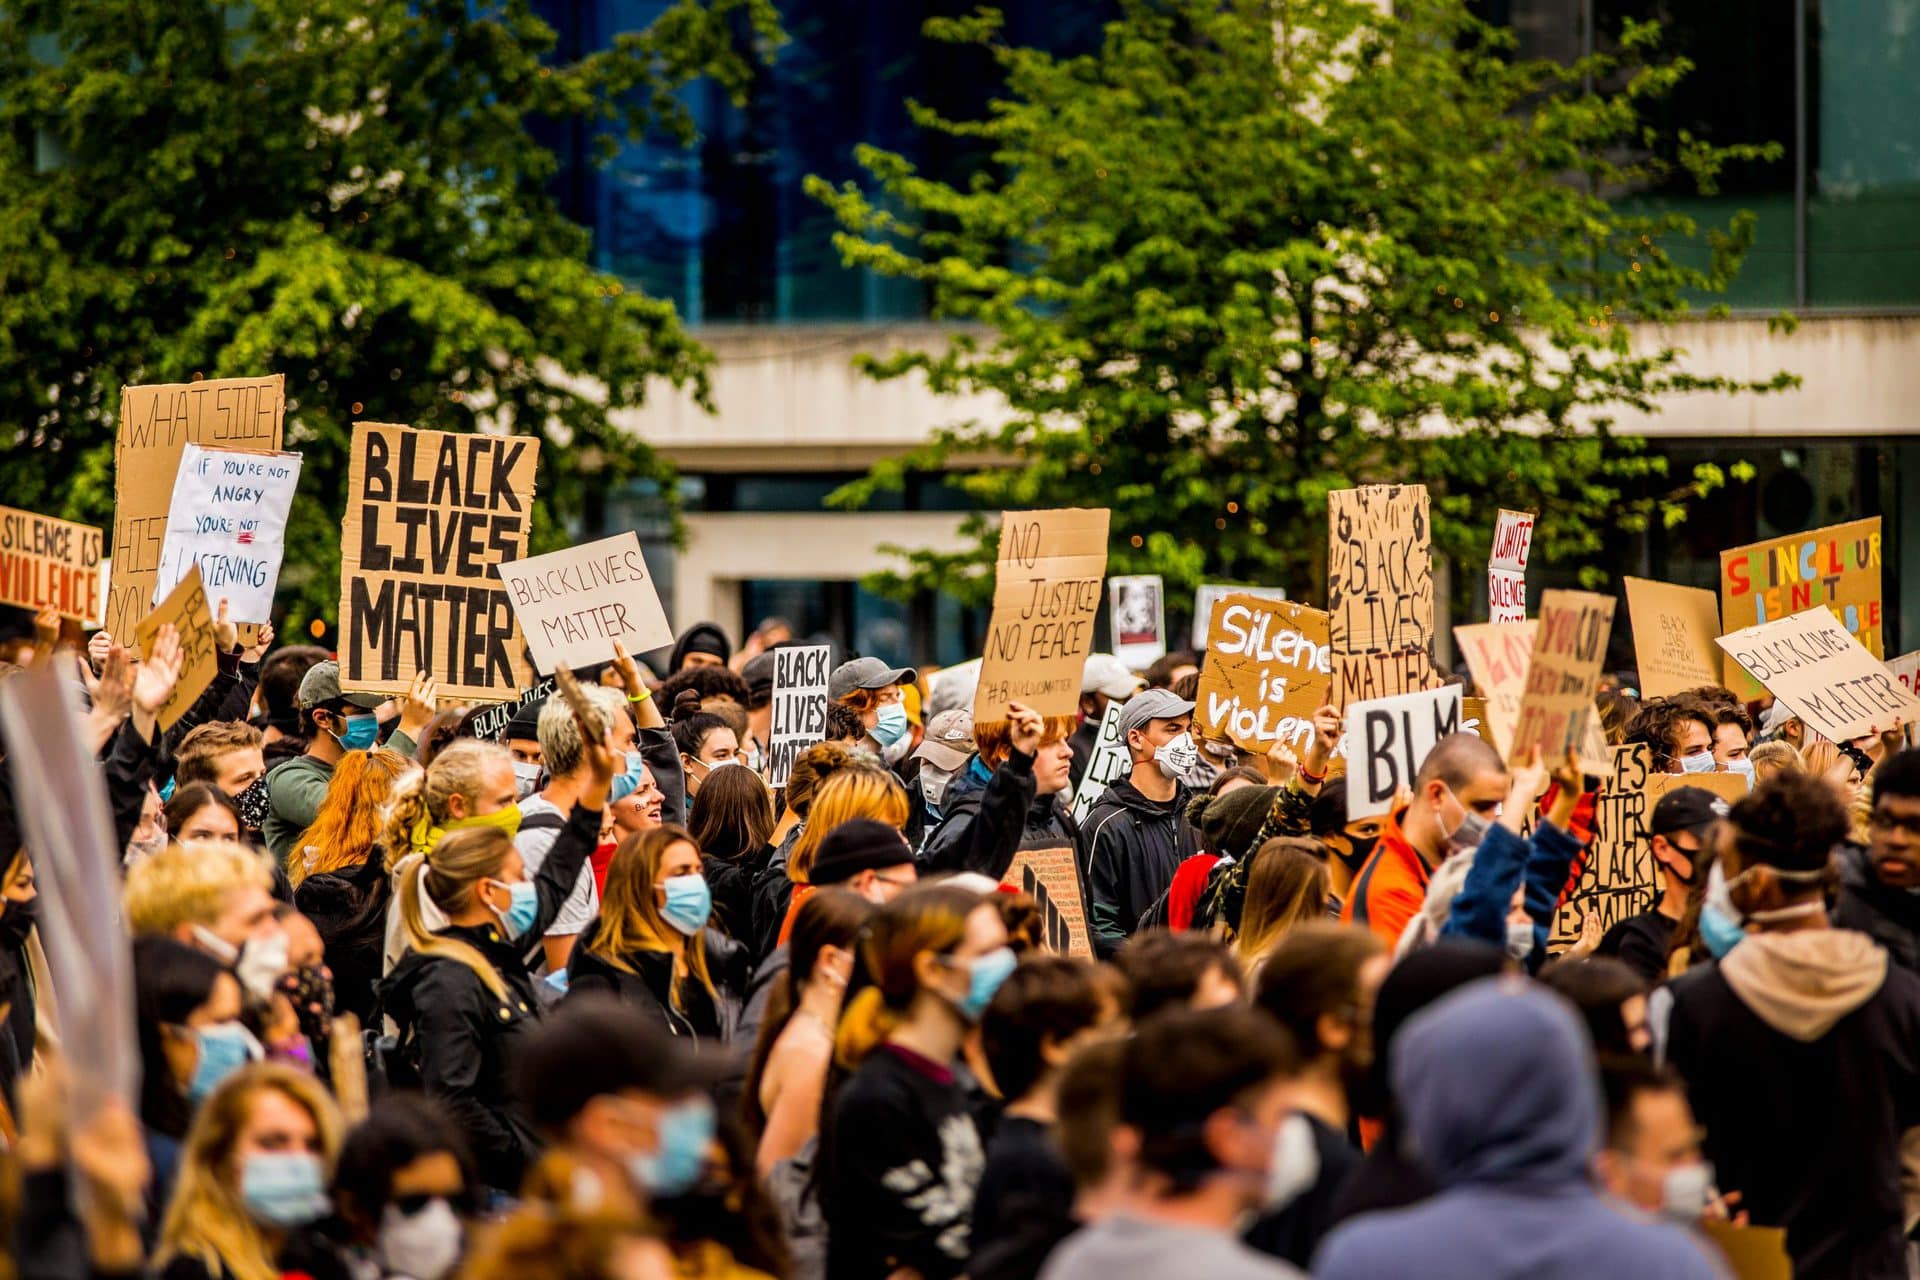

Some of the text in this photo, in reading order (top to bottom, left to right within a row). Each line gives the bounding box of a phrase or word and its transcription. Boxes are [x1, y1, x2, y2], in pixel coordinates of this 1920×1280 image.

[128, 384, 273, 448] WHAT SIDE
[198, 457, 291, 480] IF YOU'RE NOT
[363, 431, 527, 513] BLACK
[211, 484, 265, 505] ANGRY
[1, 514, 99, 568] SILENCE IS
[115, 515, 168, 574] HIS
[239, 518, 261, 532] NOT
[359, 503, 522, 580] LIVES
[1007, 521, 1041, 570] NO
[1495, 521, 1532, 566] WHITE
[0, 550, 97, 618] VIOLENCE
[511, 550, 644, 606] BLACK LIVES
[1349, 535, 1416, 596] BLACK
[1021, 578, 1099, 621] JUSTICE
[1491, 574, 1525, 608] SILENCE
[1755, 575, 1841, 627] IS NOT
[348, 576, 516, 690] MATTER
[541, 602, 637, 648] MATTER
[989, 620, 1087, 662] NO PEACE
[1346, 591, 1425, 656] LIVES
[1659, 613, 1687, 634] BLACK
[1664, 631, 1687, 649] LIVES
[777, 649, 828, 689] BLACK
[1737, 637, 1818, 681] BLACK
[1799, 628, 1851, 660] LIVES
[1259, 668, 1288, 703] is
[1341, 648, 1431, 714] MATTER
[1798, 672, 1910, 729] MATTER
[473, 703, 512, 739] BLACK
[773, 693, 827, 735] LIVES
[1577, 838, 1652, 893] BLACK
